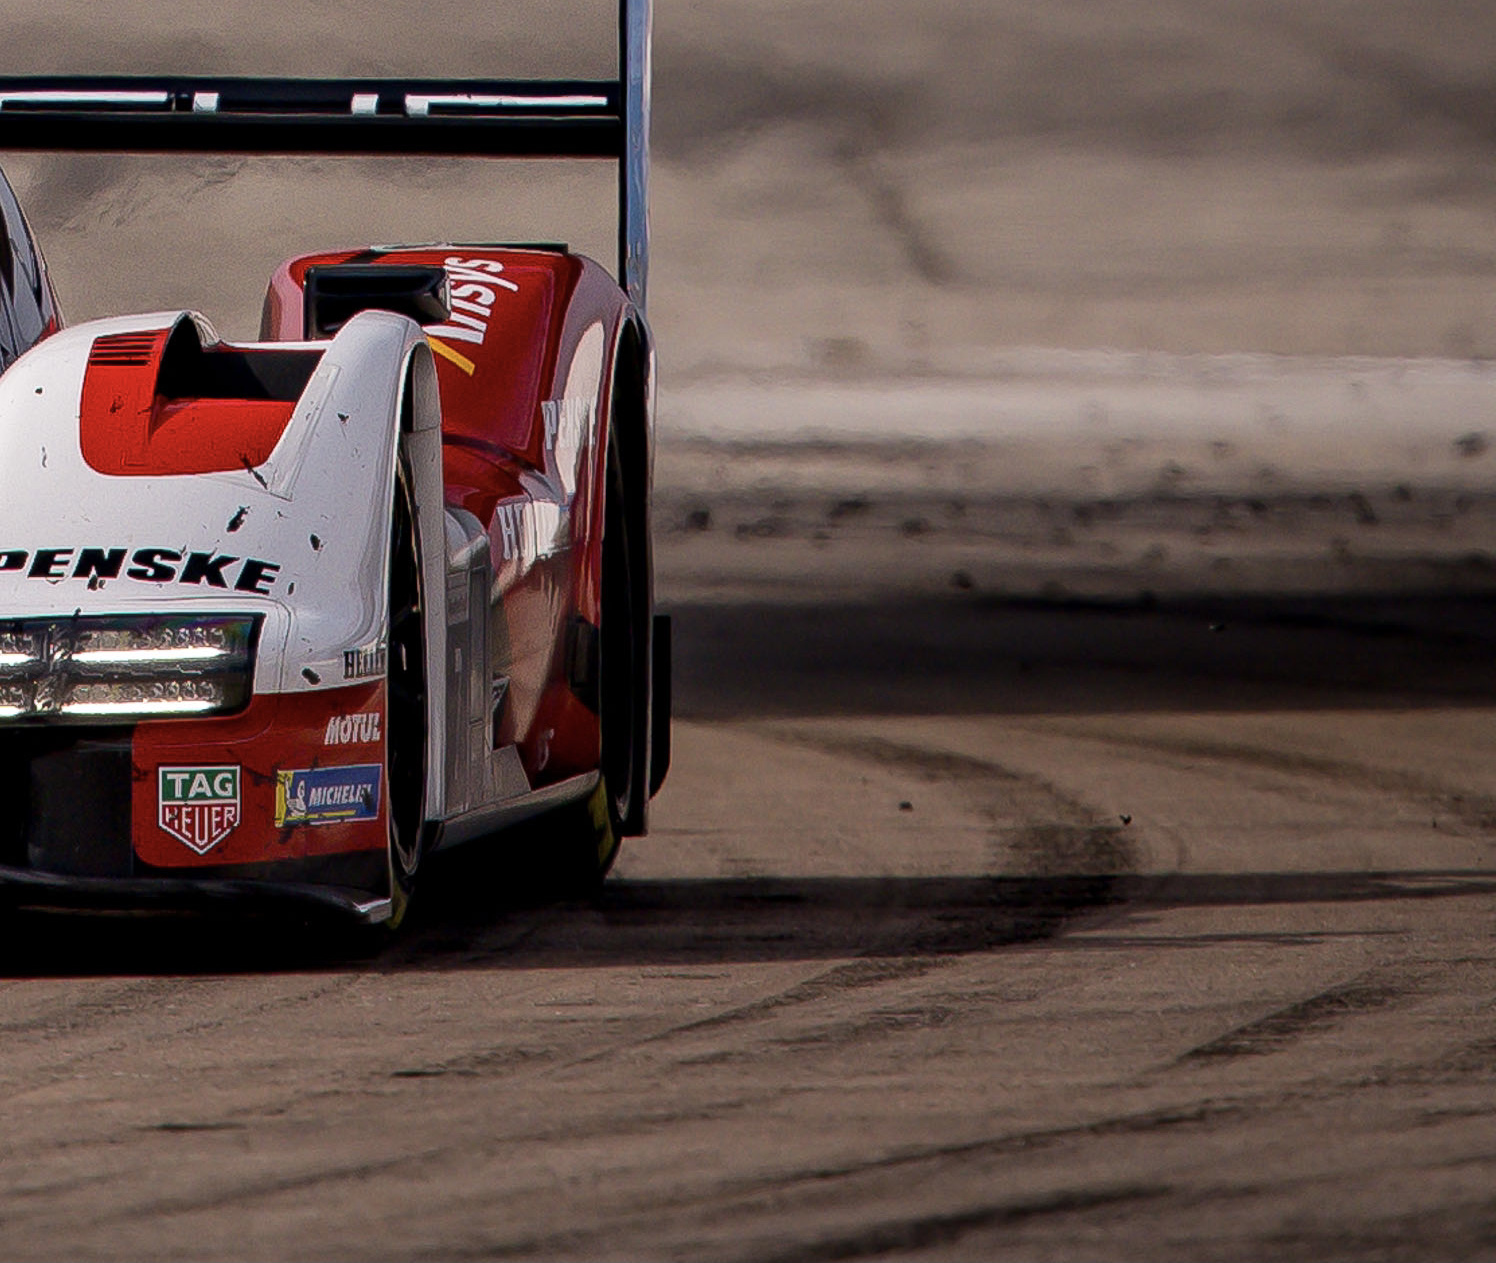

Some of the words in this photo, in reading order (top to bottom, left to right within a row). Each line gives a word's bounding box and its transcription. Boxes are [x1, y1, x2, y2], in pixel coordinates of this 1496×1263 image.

[324, 713, 381, 745] MOTUL
[166, 773, 233, 798] TAG
[309, 784, 372, 807] MICHELIN
[165, 805, 235, 846] HEUER
